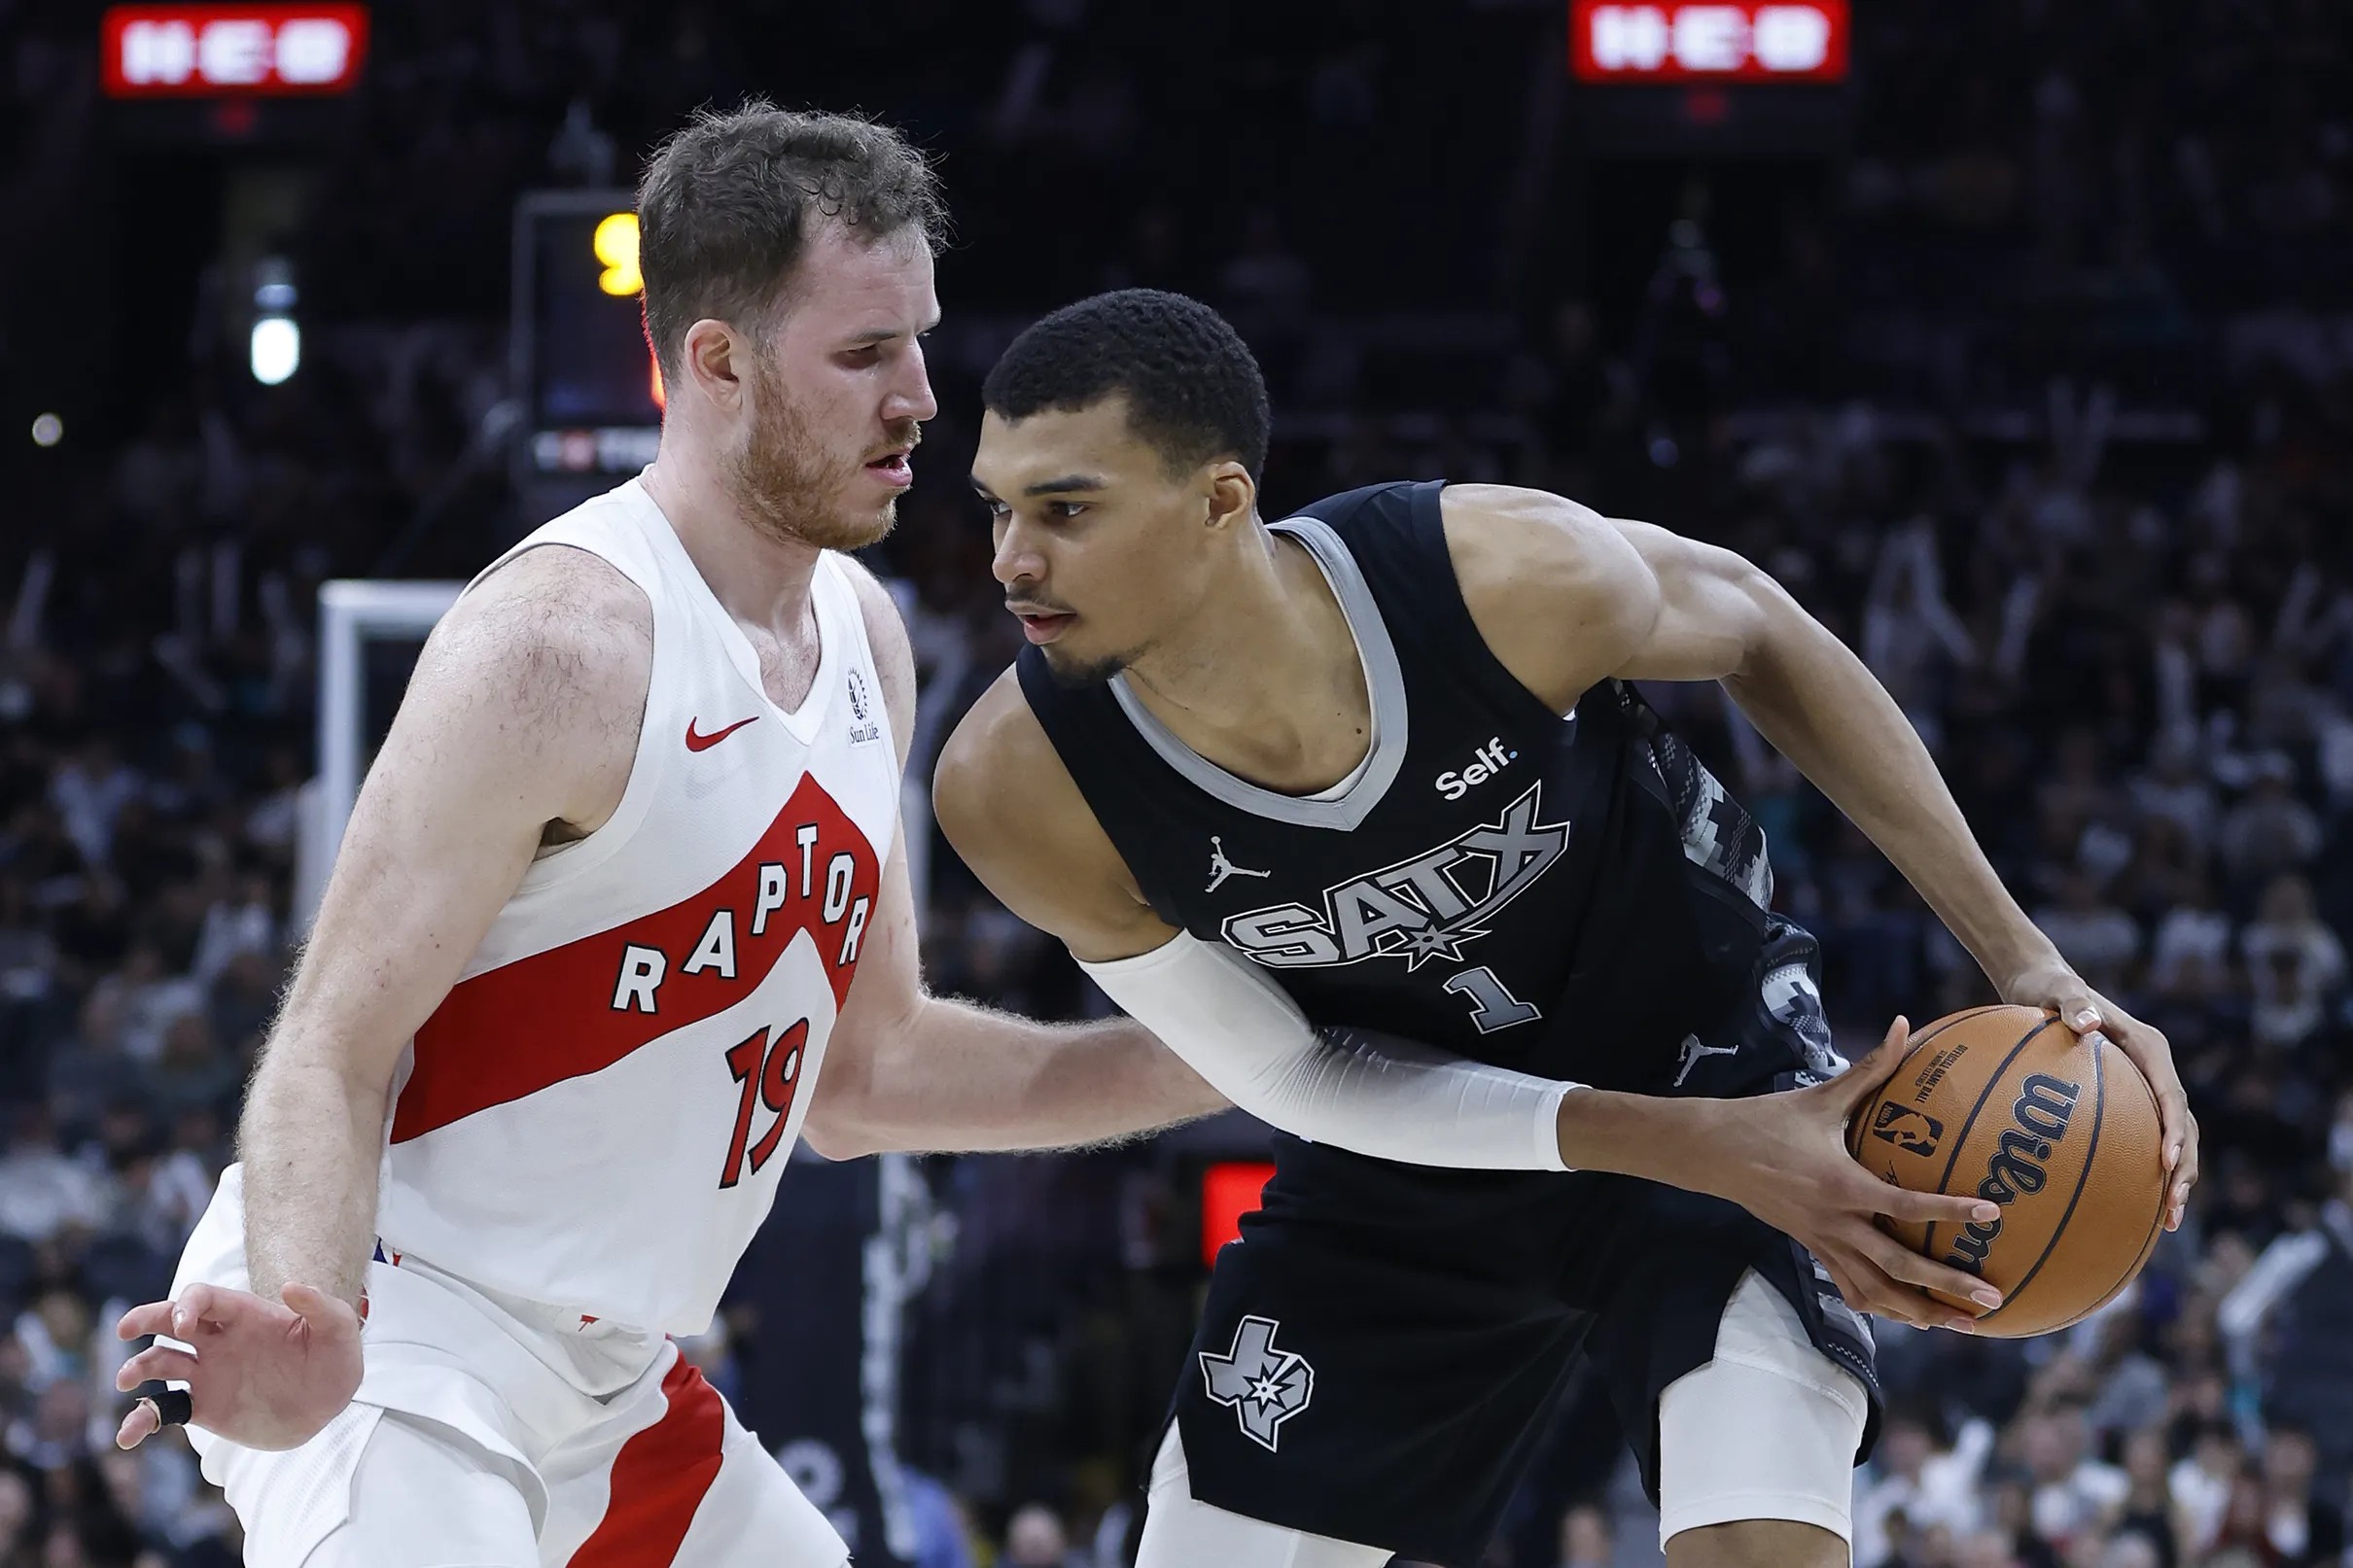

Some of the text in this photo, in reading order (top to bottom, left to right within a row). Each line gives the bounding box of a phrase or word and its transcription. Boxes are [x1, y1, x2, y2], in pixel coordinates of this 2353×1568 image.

[849, 721, 879, 744] Sun Life
[1435, 736, 1519, 801] Self.
[1219, 779, 1570, 971] SATX
[1443, 966, 1543, 1034] 1
[718, 1017, 810, 1190] 19
[1914, 1044, 1968, 1103] OFFICIAL GAME BALL
[1879, 1104, 1893, 1124] NBA
